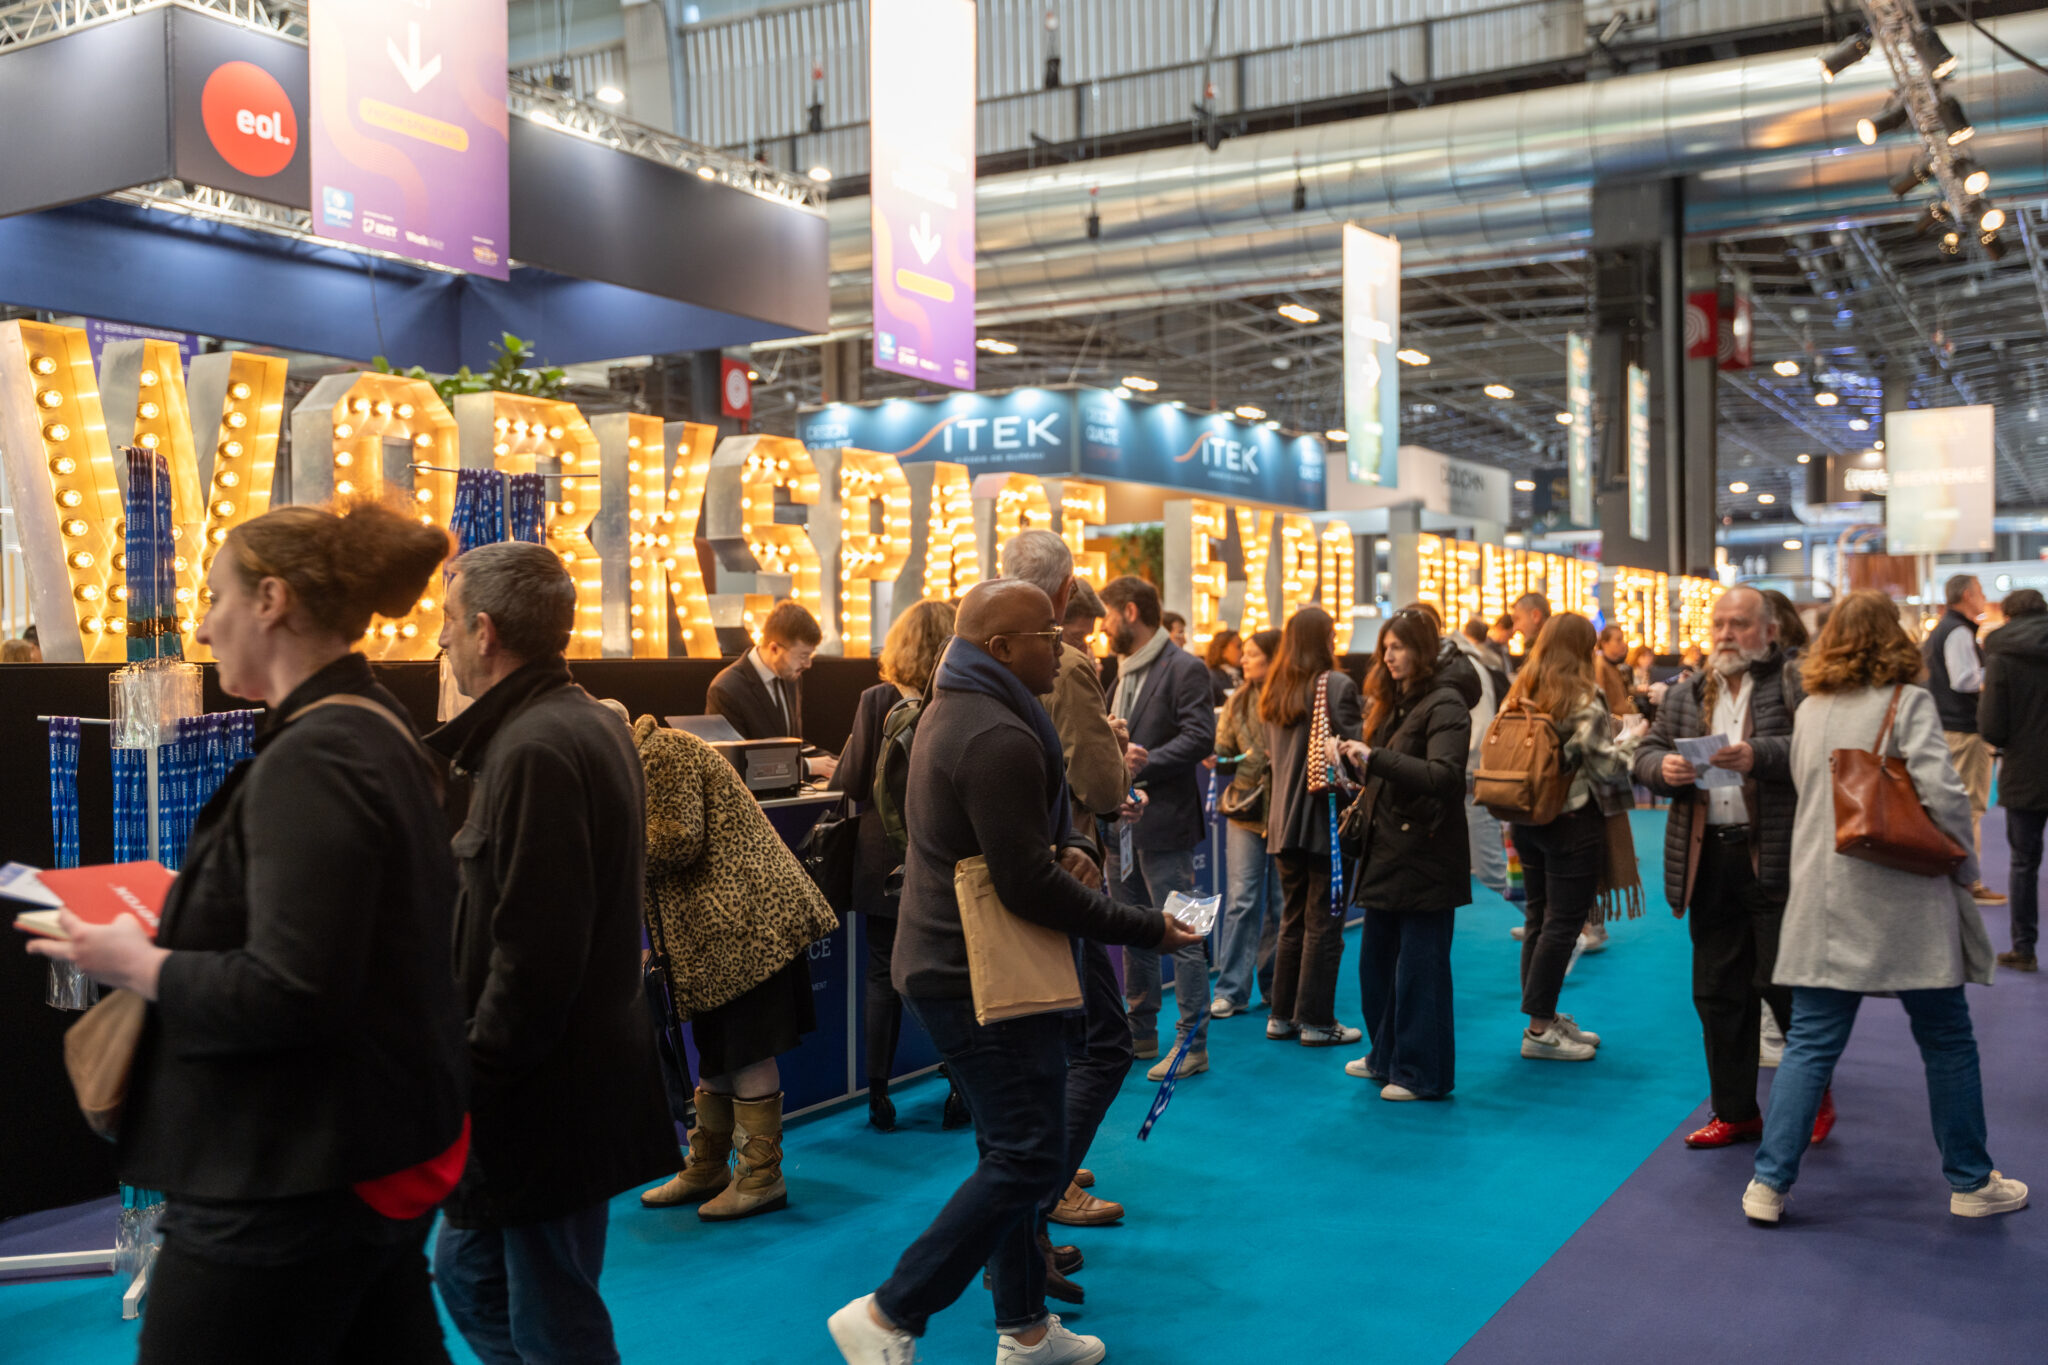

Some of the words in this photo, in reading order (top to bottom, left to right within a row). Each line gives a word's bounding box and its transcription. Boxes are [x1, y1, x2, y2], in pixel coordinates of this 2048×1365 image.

[943, 411, 1062, 453] ITEK
[1201, 435, 1260, 475] ITEK
[1163, 498, 1356, 656] EXPO
